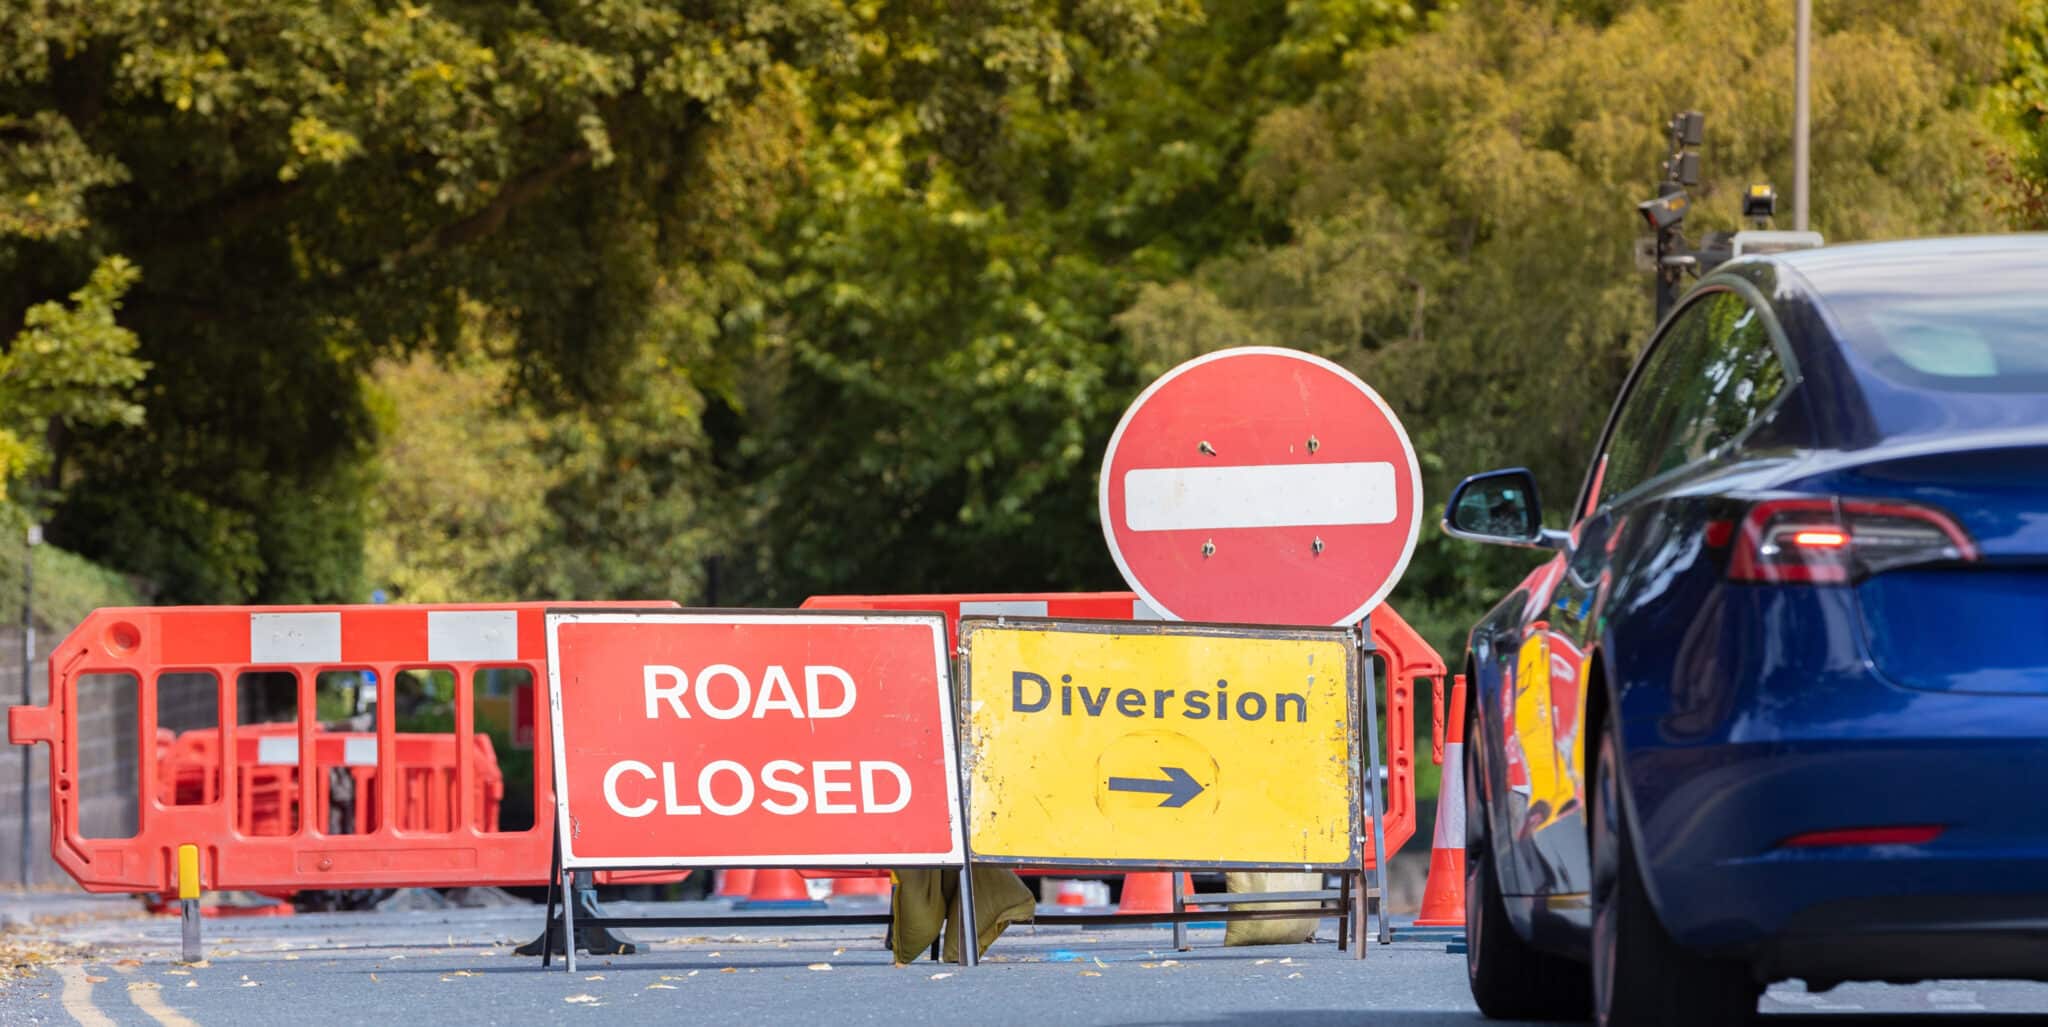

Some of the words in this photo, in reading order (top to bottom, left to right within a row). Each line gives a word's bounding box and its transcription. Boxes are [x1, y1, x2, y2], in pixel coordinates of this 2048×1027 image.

[643, 663, 857, 720] ROAD
[1012, 671, 1307, 723] Diversion
[602, 759, 913, 818] CLOSED
